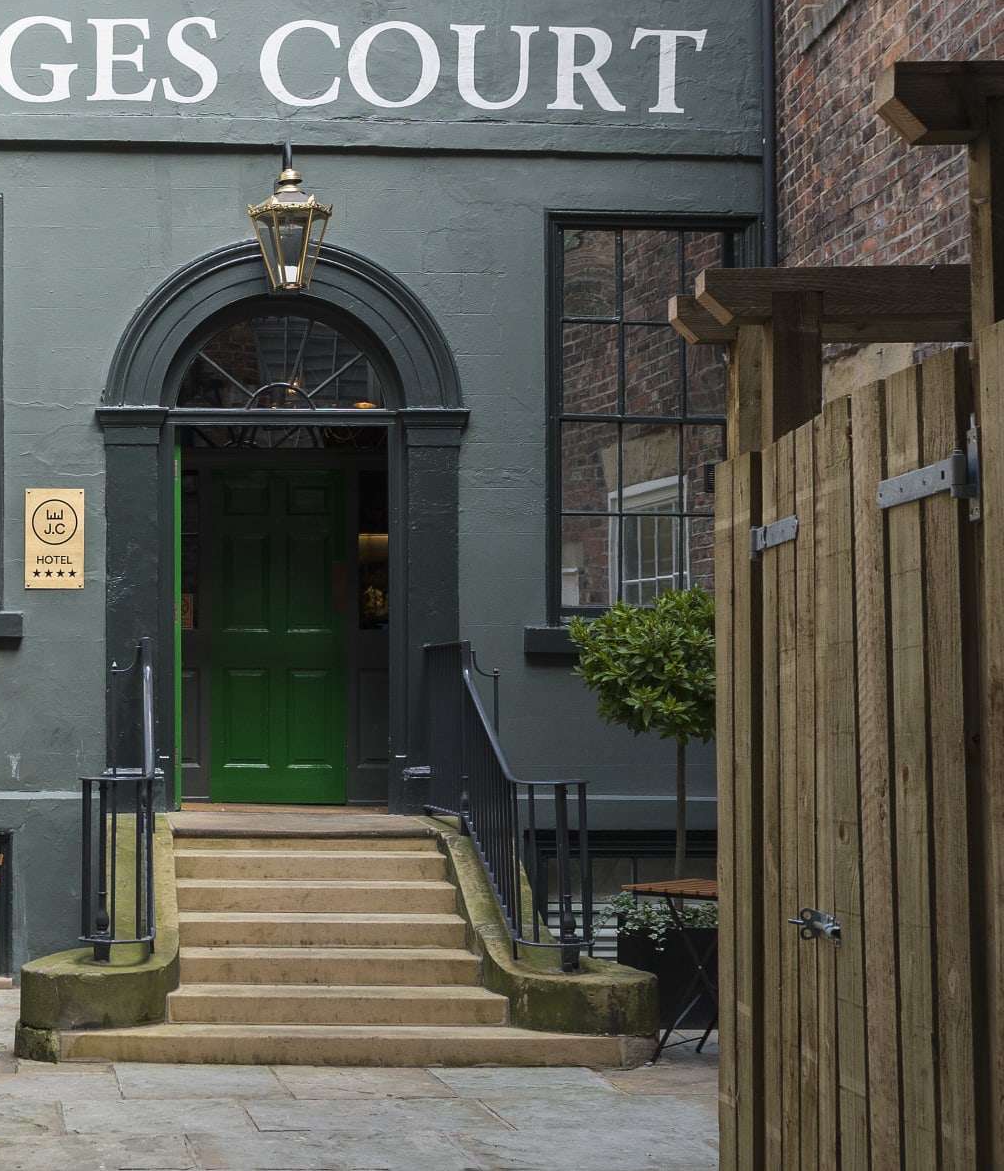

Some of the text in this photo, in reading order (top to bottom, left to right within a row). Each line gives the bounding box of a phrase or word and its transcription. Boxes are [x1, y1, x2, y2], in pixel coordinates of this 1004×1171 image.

[259, 19, 708, 115] COURT
[44, 523, 66, 535] J.C
[36, 555, 73, 565] HOTEL
